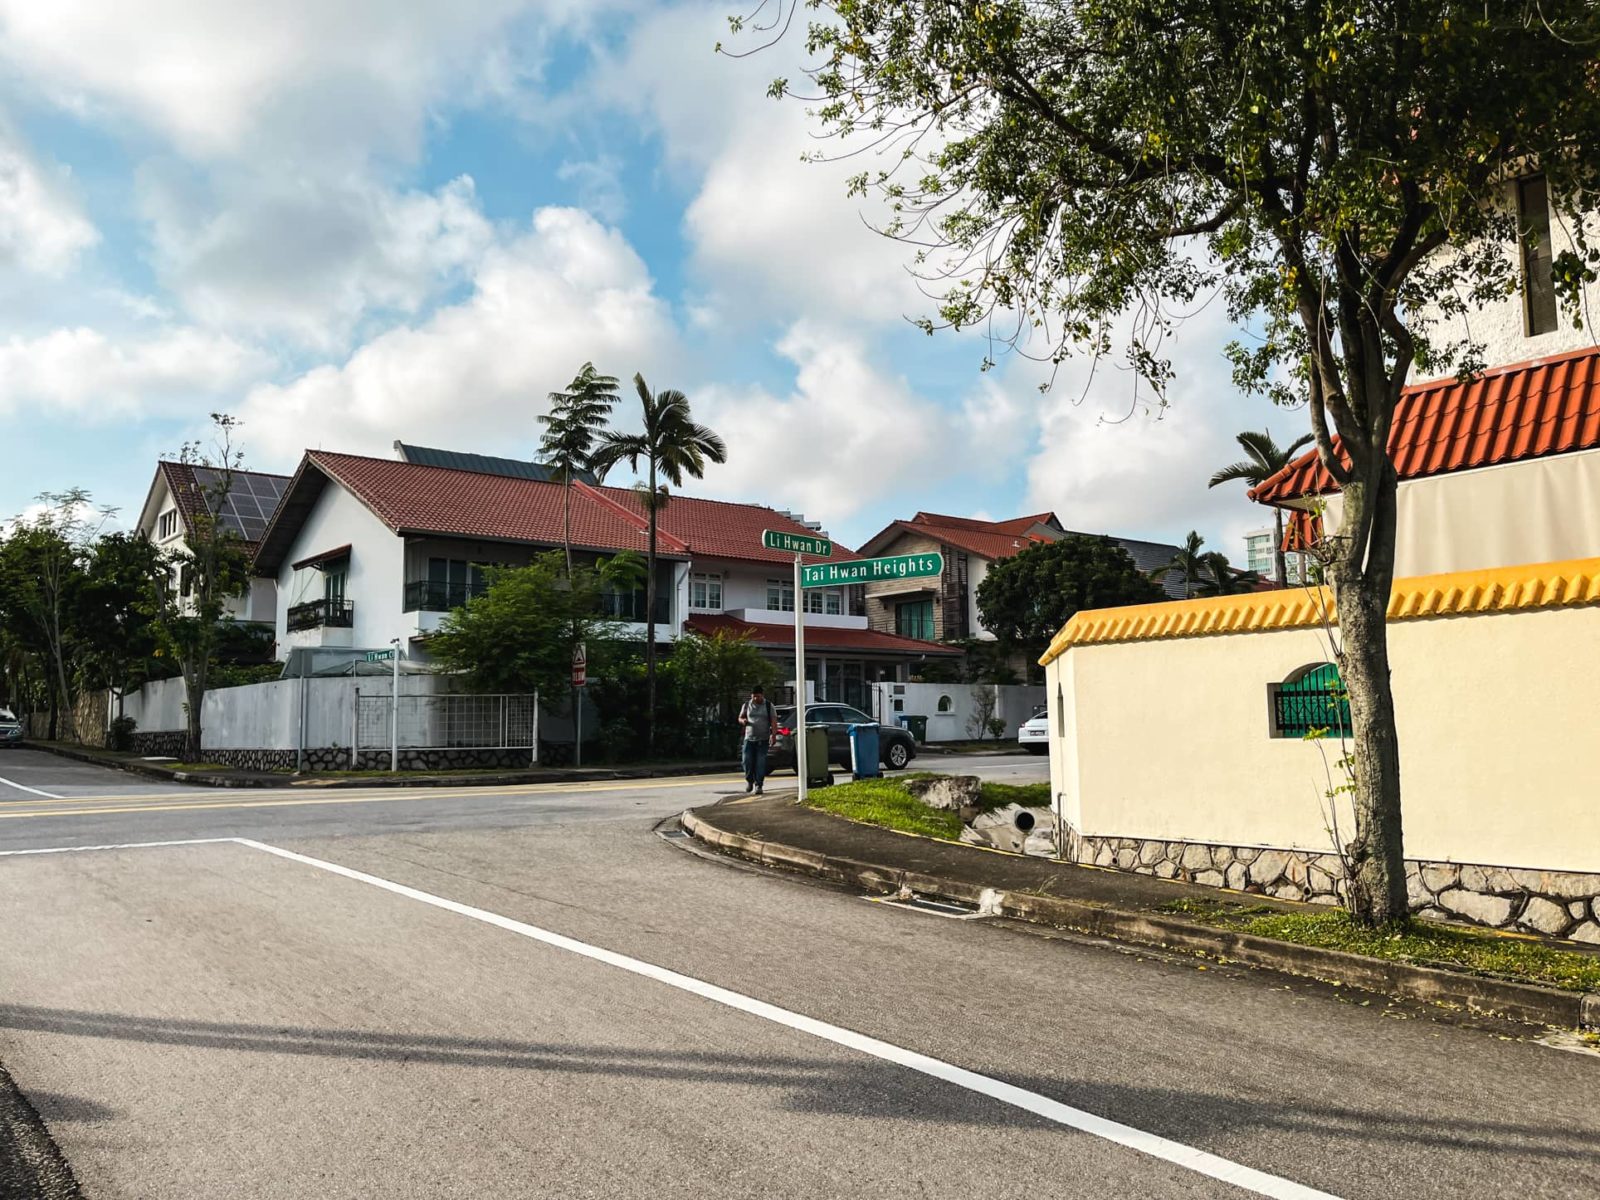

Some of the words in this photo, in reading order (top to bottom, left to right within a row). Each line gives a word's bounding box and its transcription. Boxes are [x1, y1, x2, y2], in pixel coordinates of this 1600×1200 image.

[770, 533, 780, 547] Li
[784, 536, 812, 552] Hwan
[815, 540, 827, 555] Dr
[804, 567, 824, 582] Tai
[829, 565, 867, 579] Hwan
[873, 559, 933, 576] Heights
